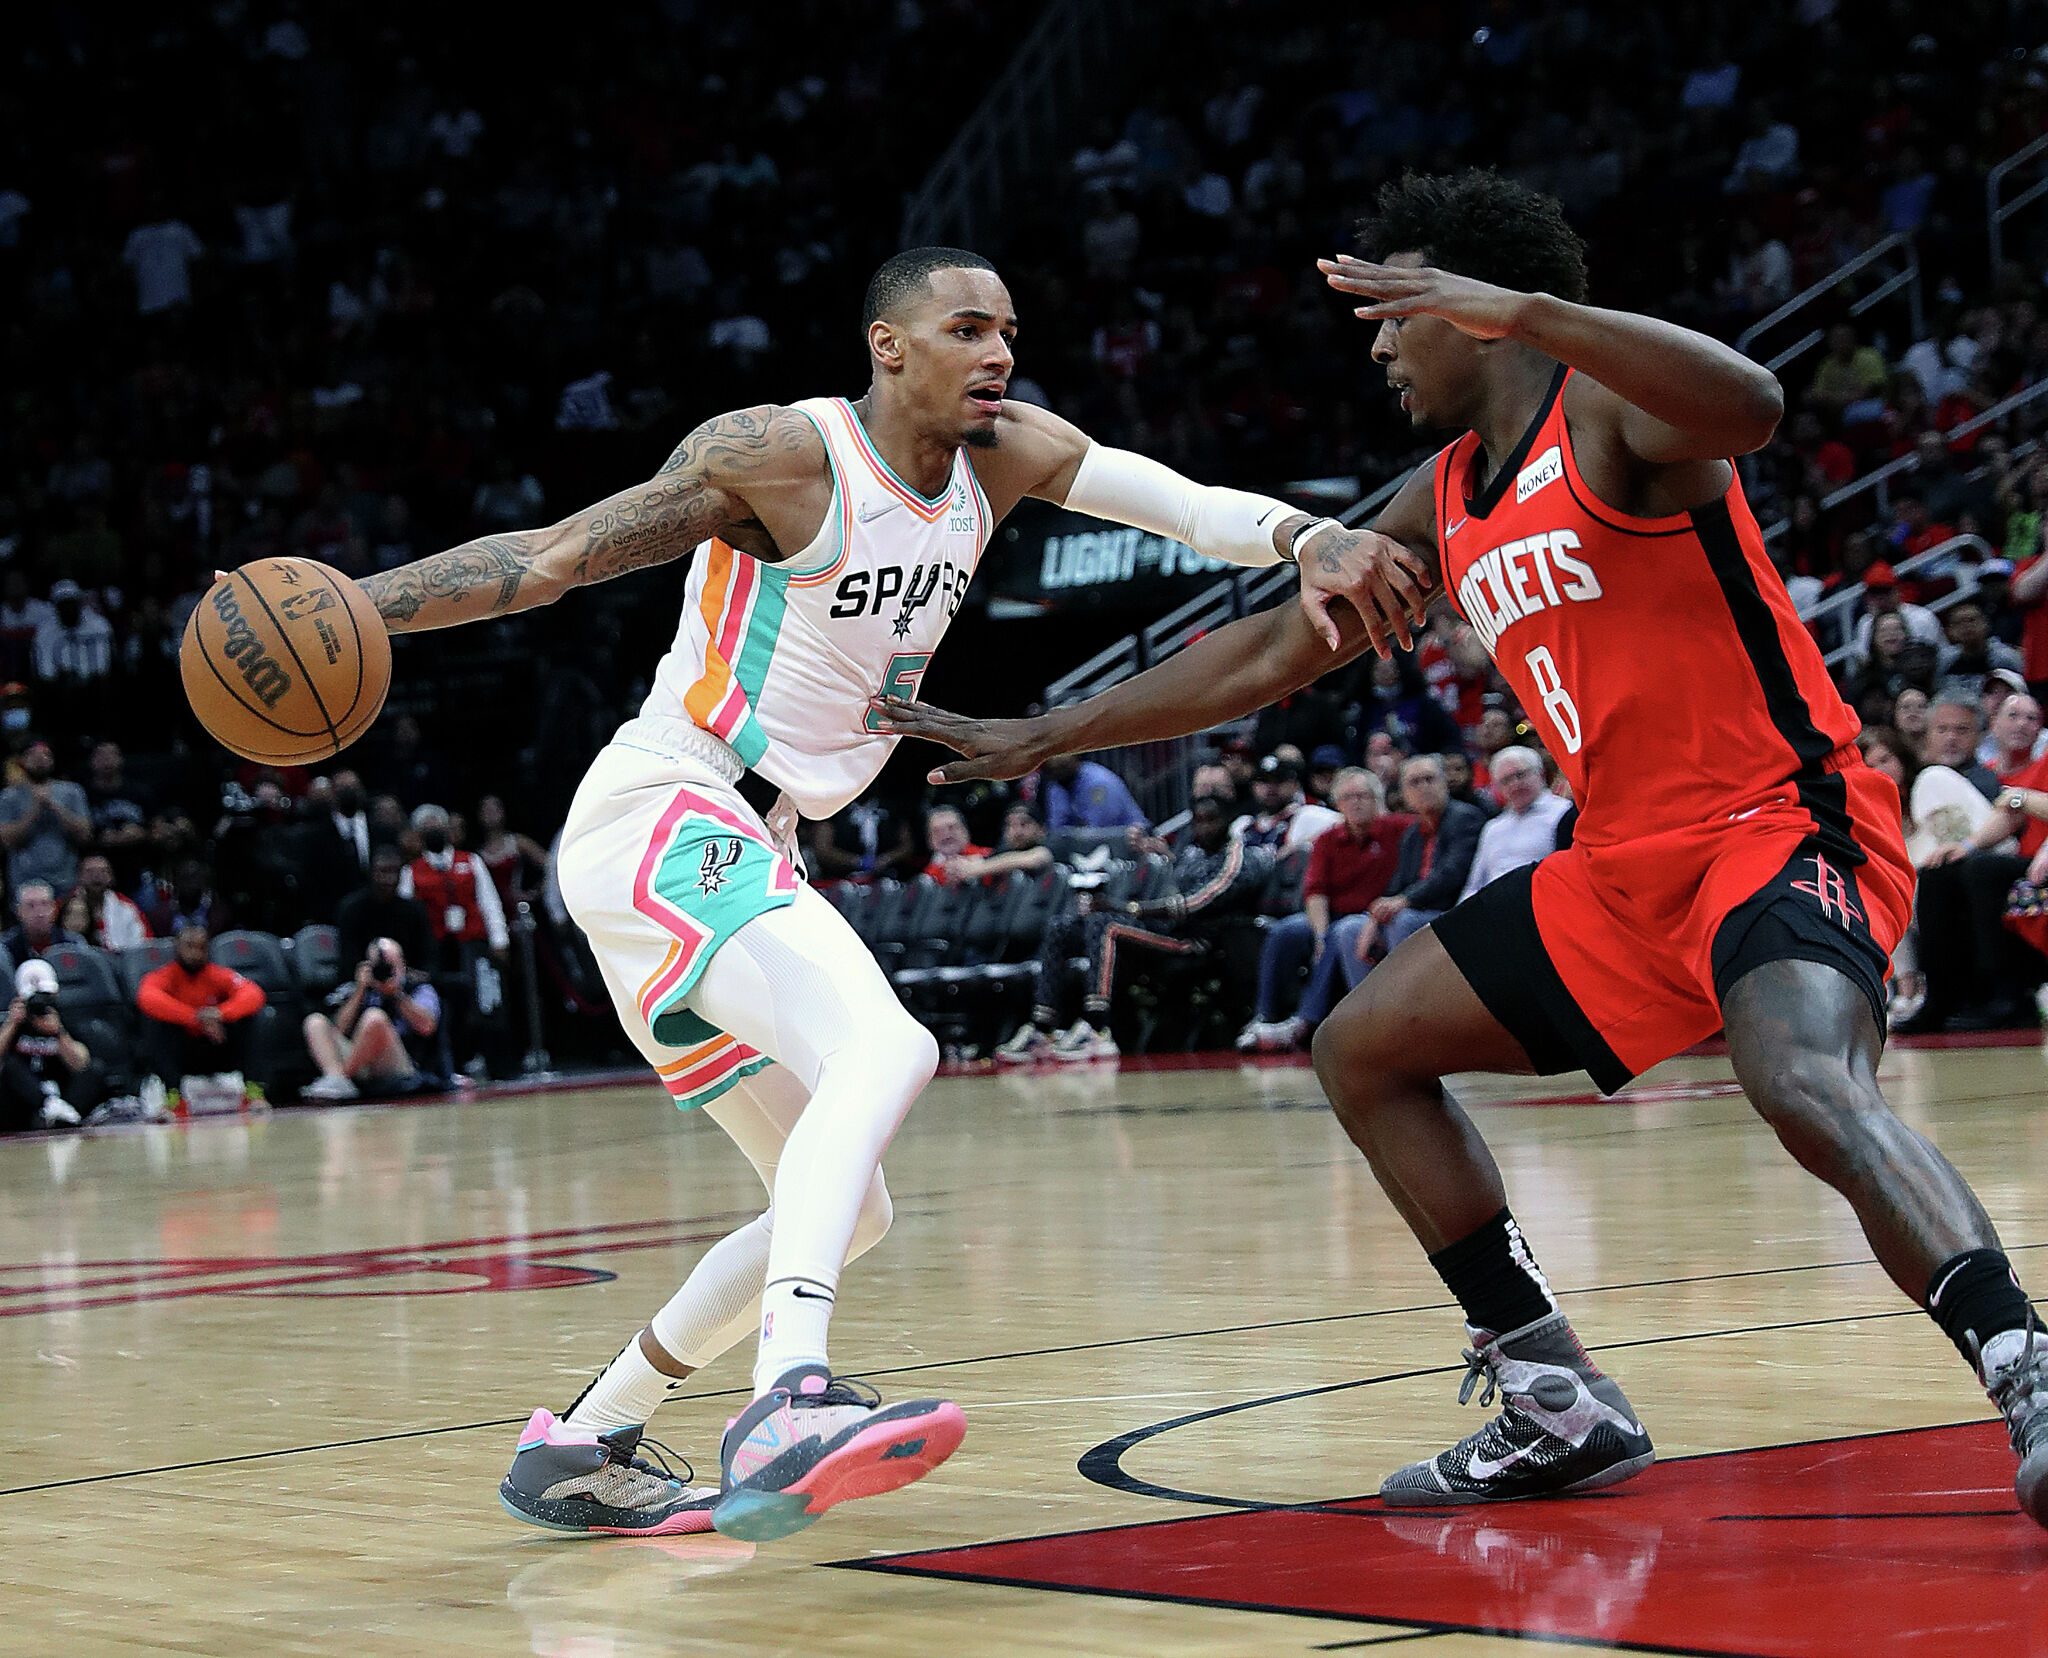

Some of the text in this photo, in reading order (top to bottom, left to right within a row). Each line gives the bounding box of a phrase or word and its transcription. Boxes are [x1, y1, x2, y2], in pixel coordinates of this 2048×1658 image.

[1518, 460, 1558, 499] MONEY
[947, 515, 975, 532] rost
[1040, 528, 1144, 589] LIGHT
[1459, 529, 1603, 660] OCKETS
[863, 651, 935, 735] 5
[1525, 645, 1582, 754] 8
